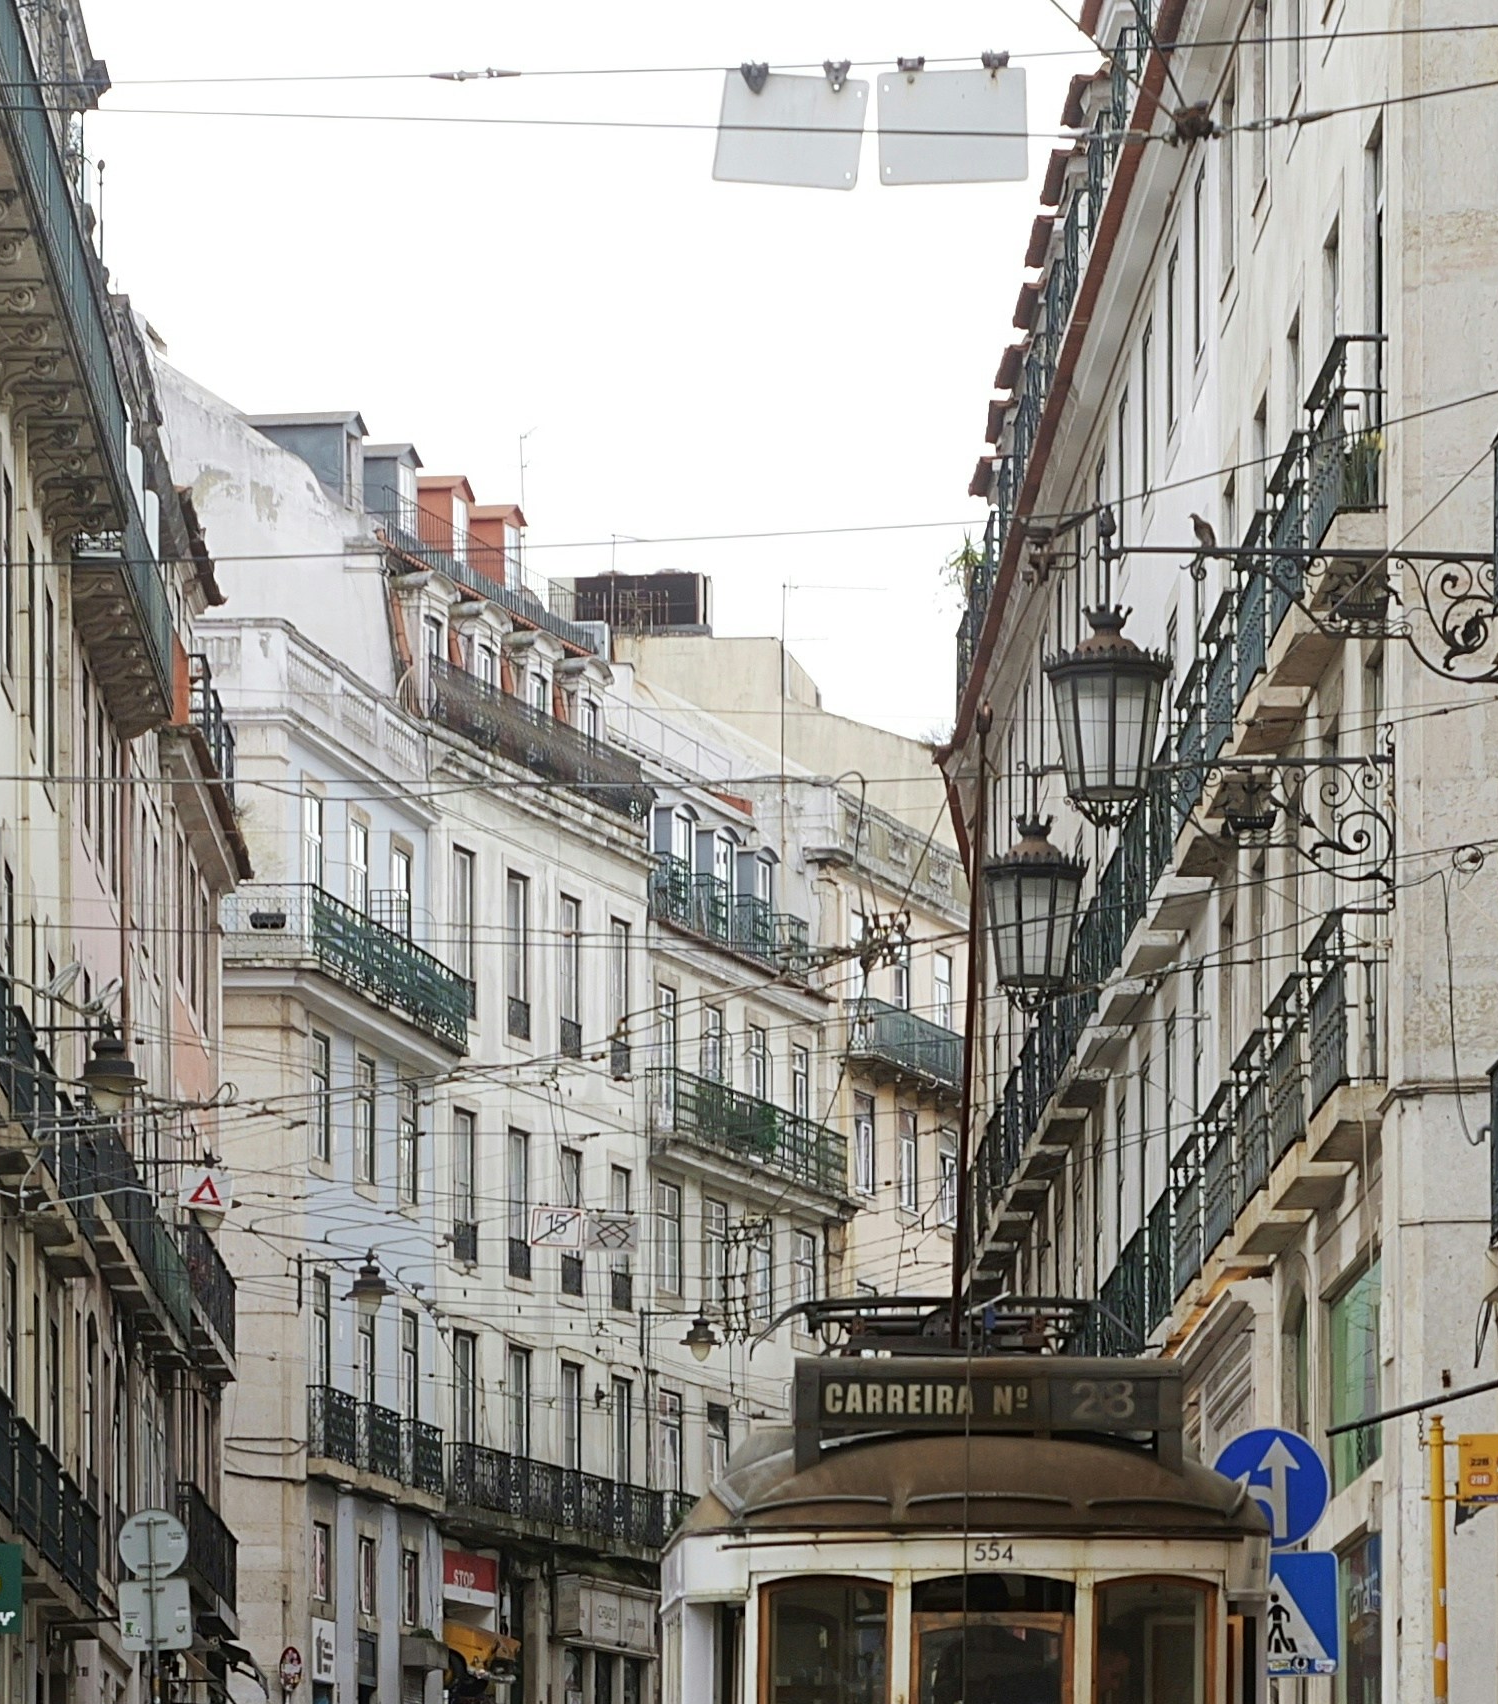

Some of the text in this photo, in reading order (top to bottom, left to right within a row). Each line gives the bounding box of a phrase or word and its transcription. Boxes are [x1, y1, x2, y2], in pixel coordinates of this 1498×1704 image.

[545, 1213, 567, 1235] 15
[824, 1382, 974, 1415] CARREIRA
[1071, 1380, 1135, 1420] 28
[973, 1542, 1014, 1564] 554
[453, 1568, 476, 1588] STOP
